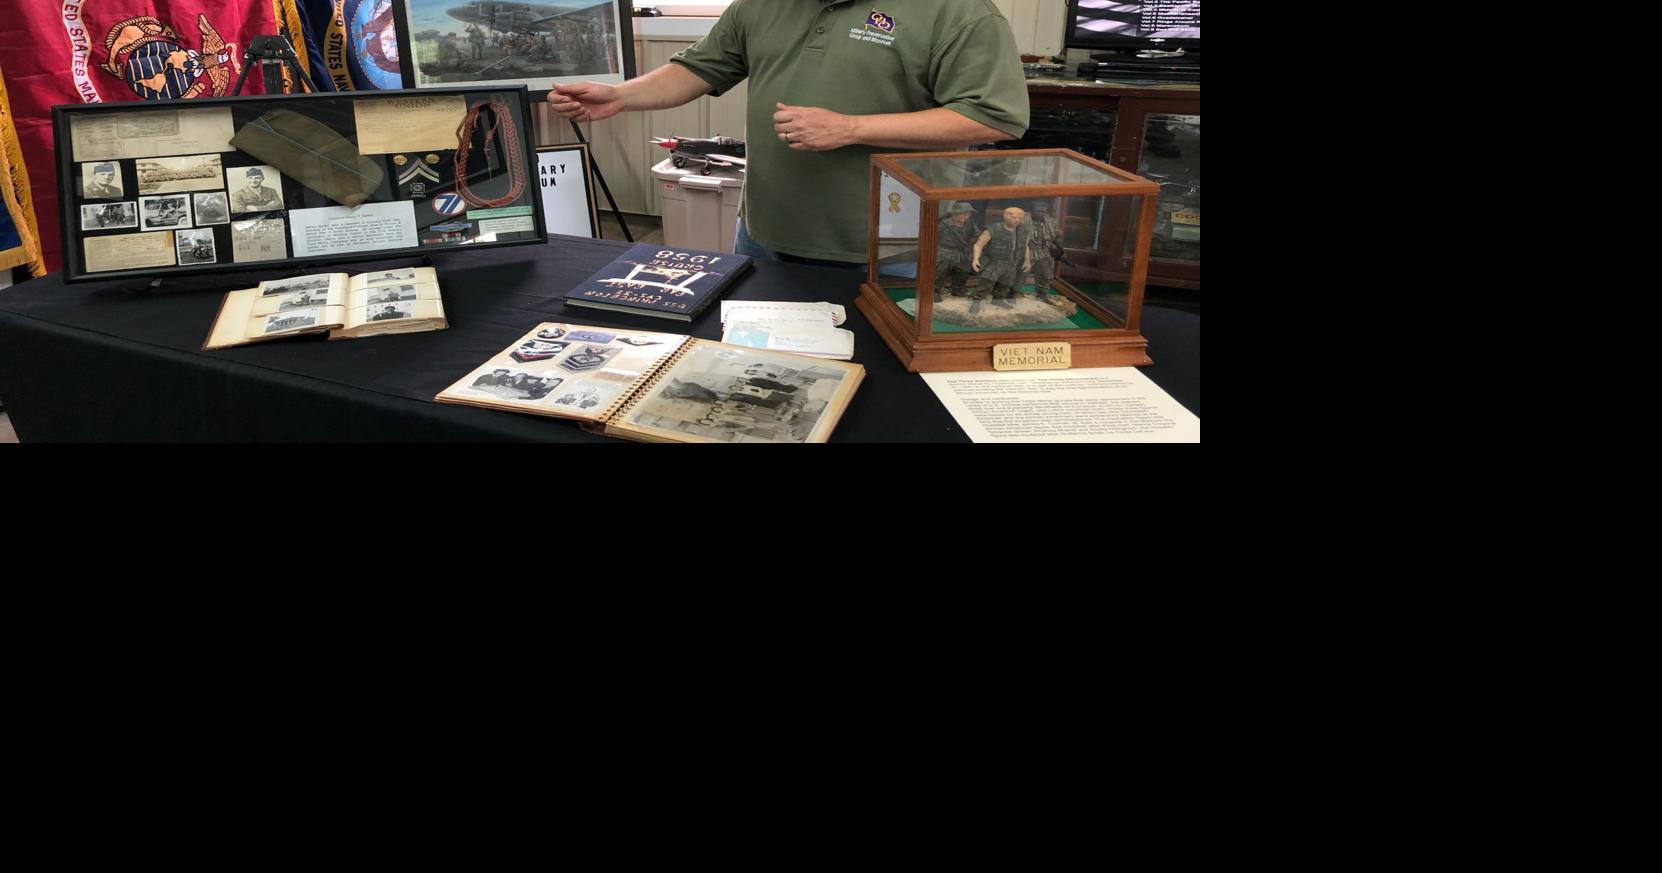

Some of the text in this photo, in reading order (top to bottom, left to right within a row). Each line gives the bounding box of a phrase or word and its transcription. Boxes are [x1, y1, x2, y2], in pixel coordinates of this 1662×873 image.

[328, 32, 344, 70] STATES
[69, 28, 89, 77] STATES
[79, 81, 102, 103] MA
[333, 74, 351, 91] NAV
[541, 163, 566, 176] ARY
[541, 177, 557, 188] UM
[655, 250, 722, 264] 1958
[648, 258, 704, 271] CRUISE
[584, 289, 687, 310] USS PRINCETON
[999, 346, 1064, 356] VIET NAM
[998, 355, 1066, 366] MEMORIAL
